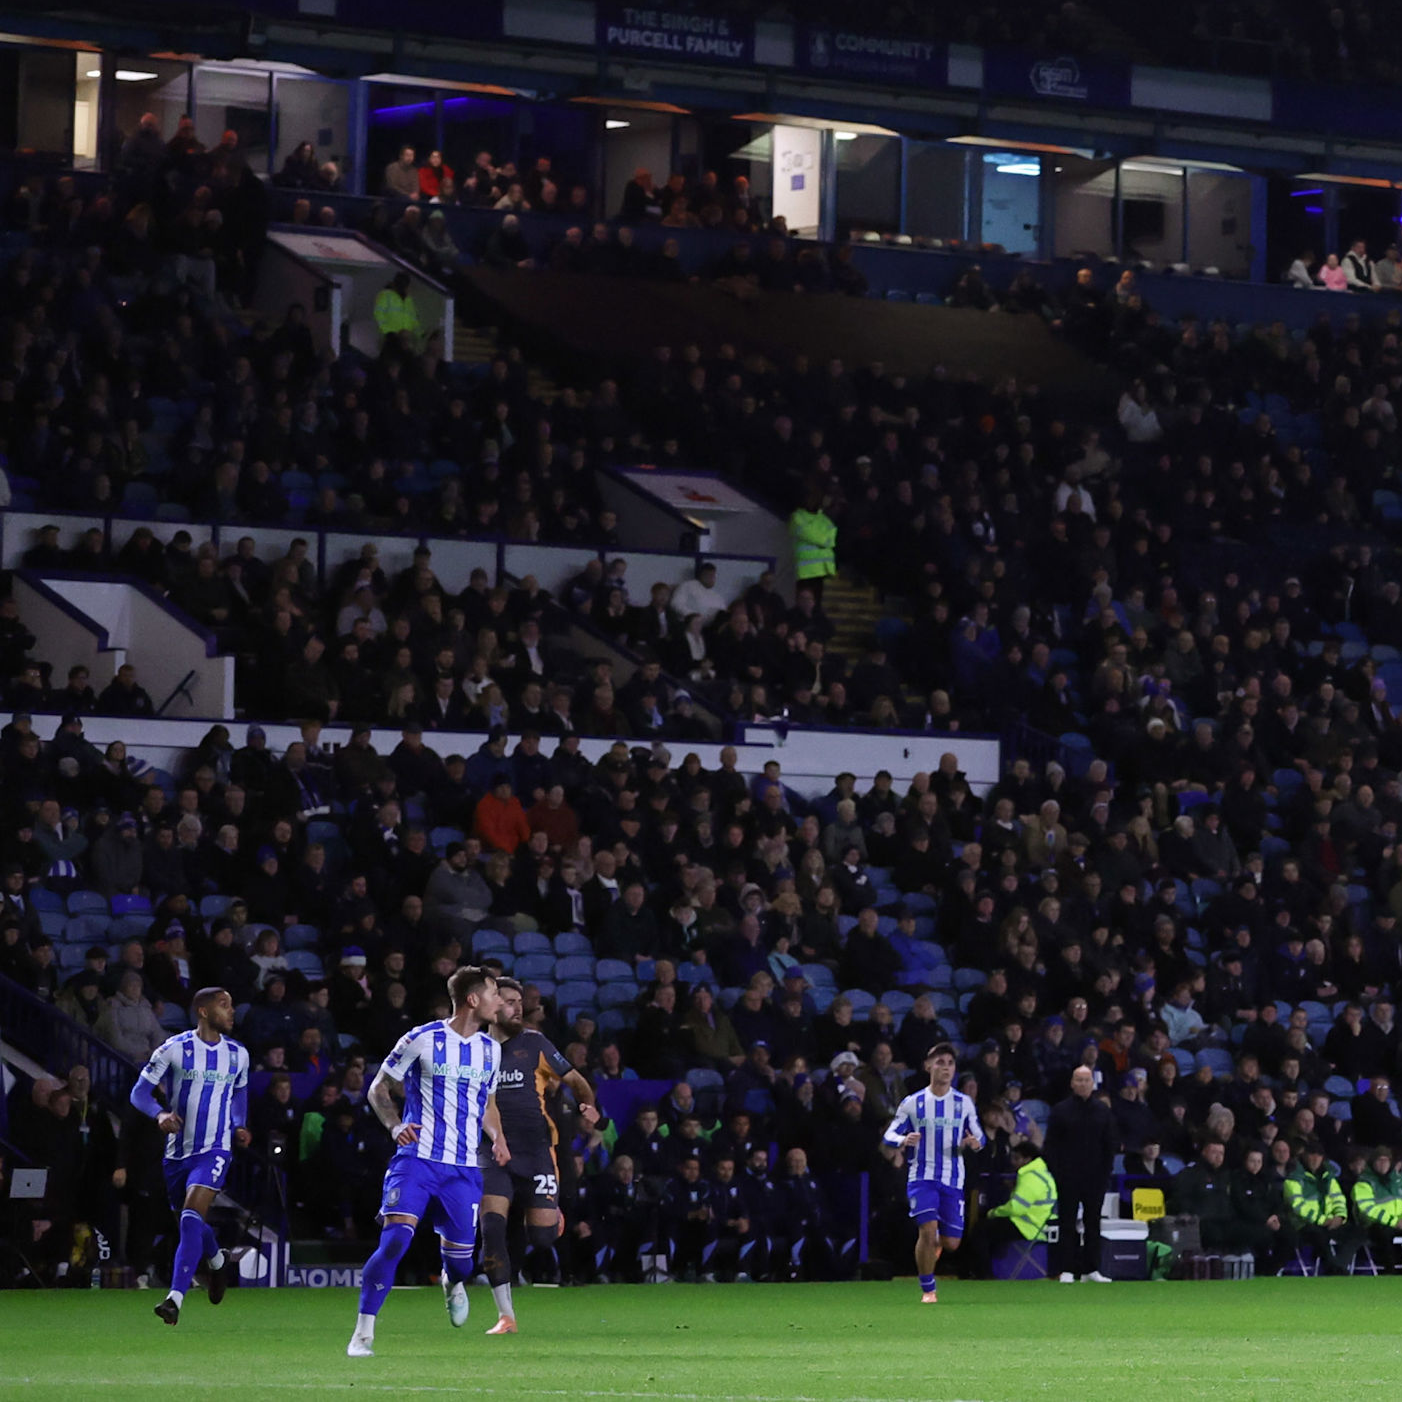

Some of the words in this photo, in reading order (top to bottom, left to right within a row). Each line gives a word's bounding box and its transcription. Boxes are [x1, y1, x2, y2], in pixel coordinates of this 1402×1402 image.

[623, 7, 658, 27] THE
[607, 26, 683, 51] PURCELL
[686, 35, 744, 58] FAMILY
[211, 1156, 225, 1178] 3
[534, 1174, 558, 1195] 25
